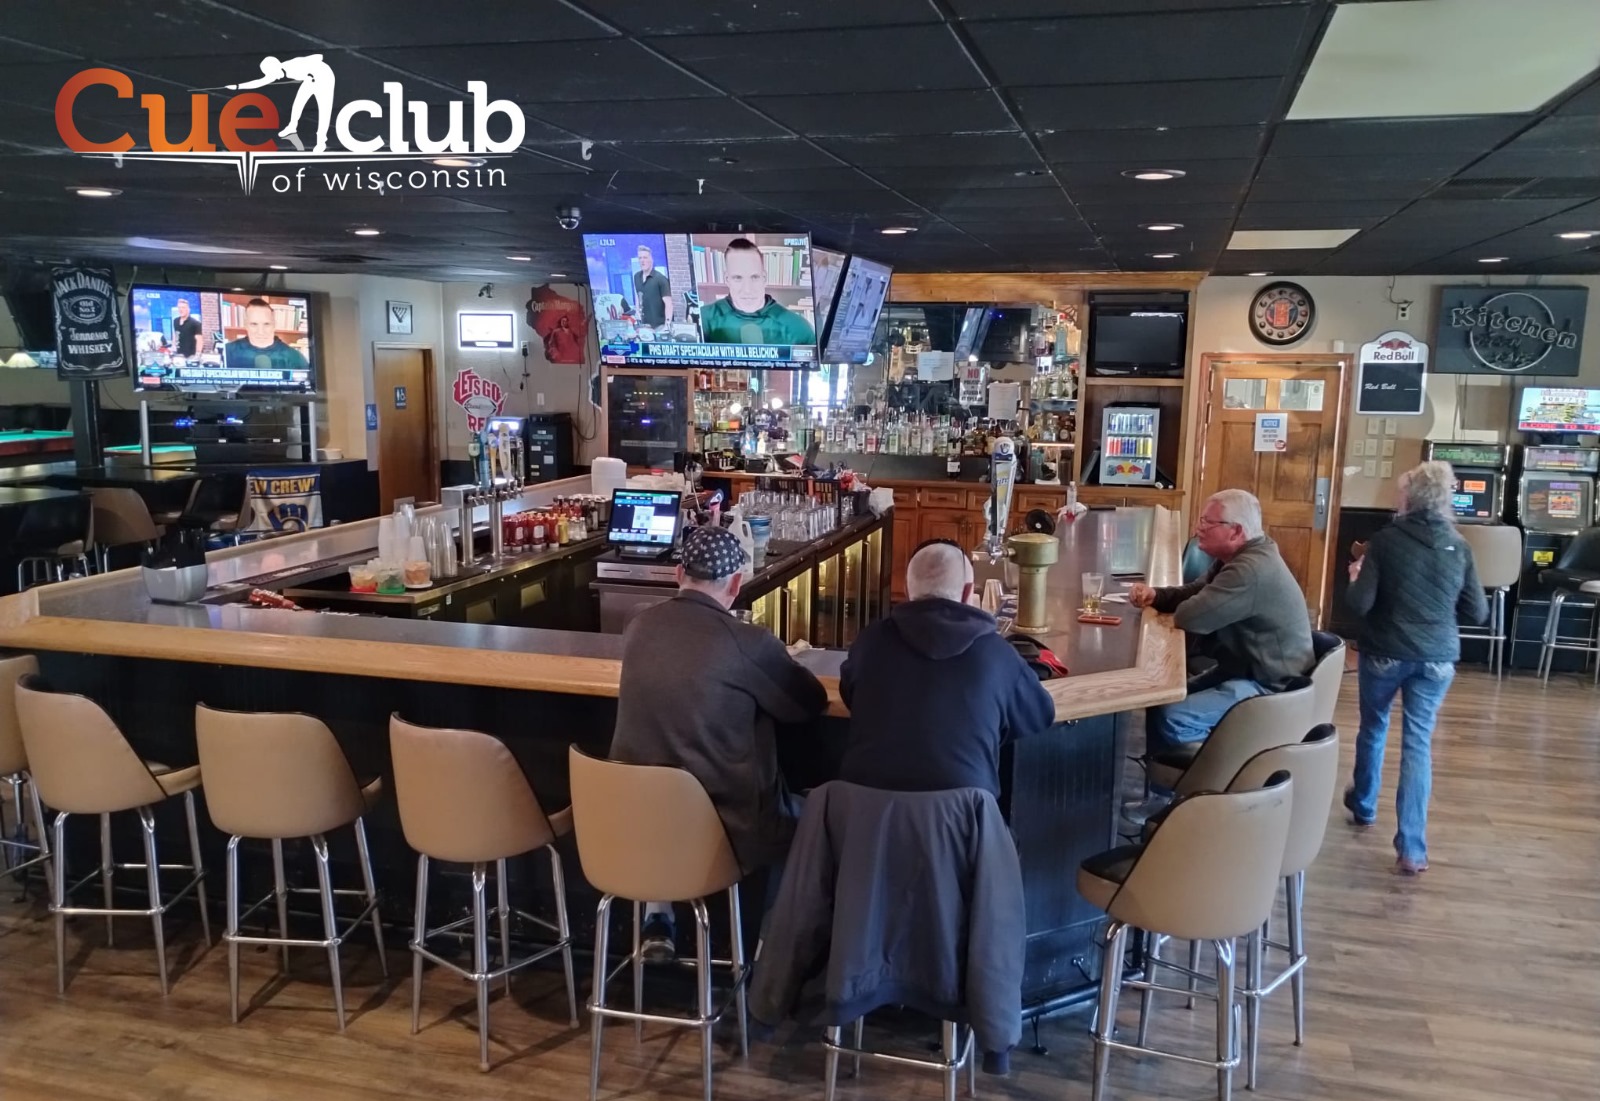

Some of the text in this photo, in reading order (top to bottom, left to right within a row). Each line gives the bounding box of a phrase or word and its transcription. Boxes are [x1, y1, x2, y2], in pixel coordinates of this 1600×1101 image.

[54, 277, 78, 298] JACK
[69, 327, 109, 341] Tennessee
[1451, 306, 1577, 349] Kitchen
[67, 342, 113, 354] WHISKEY
[662, 345, 680, 357] DRAFT
[680, 345, 720, 358] SPECTACULAR
[720, 346, 735, 358] WITH
[736, 346, 748, 358] BILL
[1373, 351, 1415, 361] Red Bull
[482, 379, 501, 403] GO
